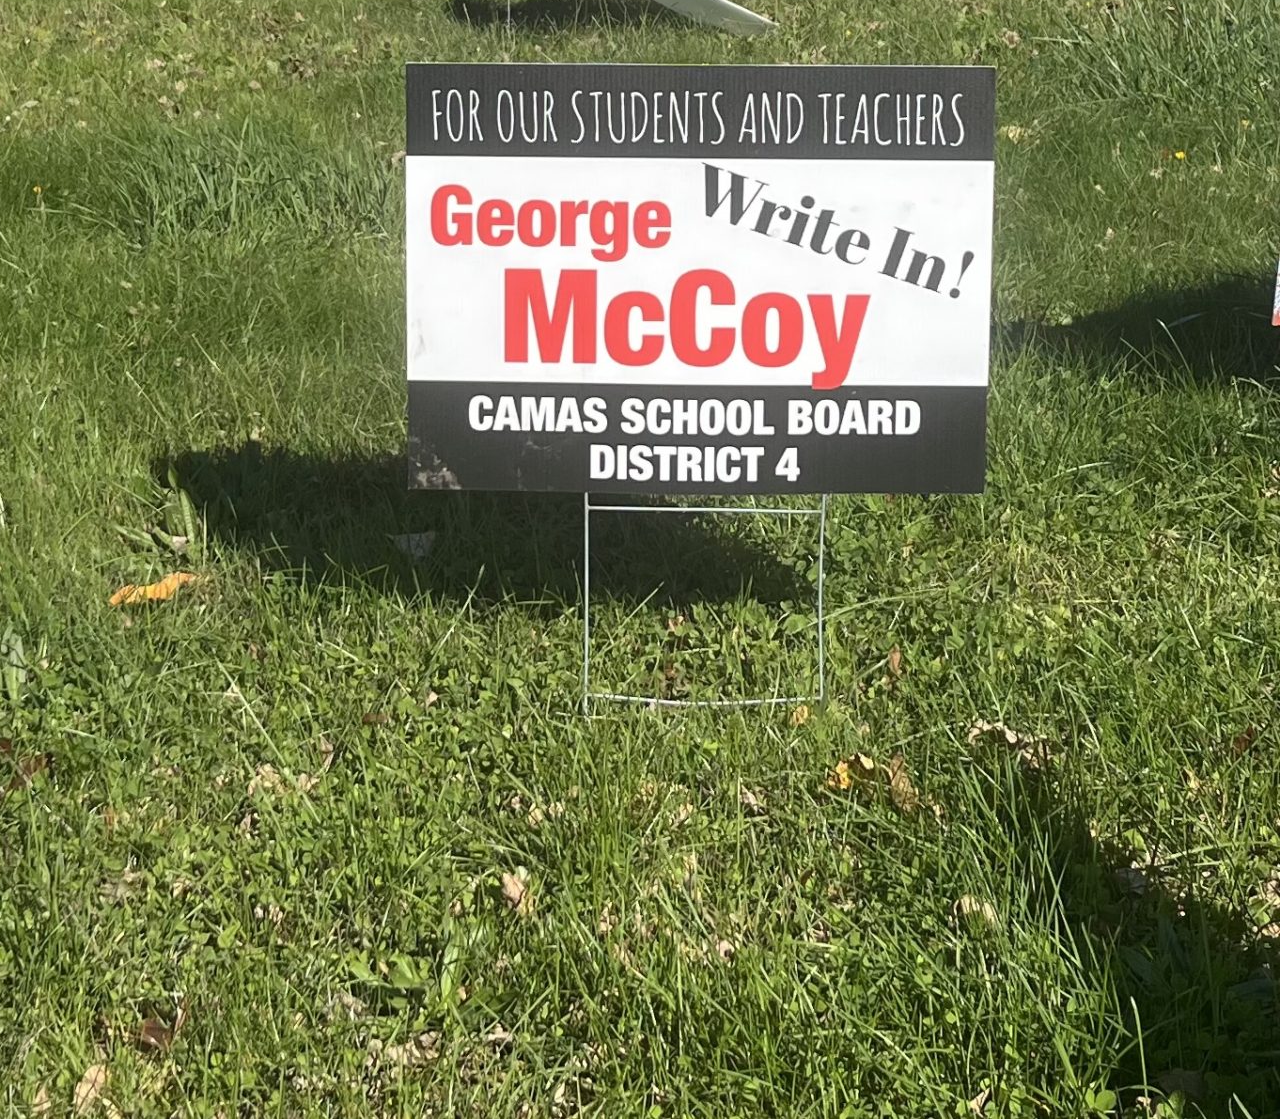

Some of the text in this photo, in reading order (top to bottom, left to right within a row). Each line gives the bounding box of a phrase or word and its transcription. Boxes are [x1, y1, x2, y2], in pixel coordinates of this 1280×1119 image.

[431, 88, 966, 148] FOR OUR STUDENTS AND TEACHERS
[430, 184, 672, 262] George
[701, 161, 976, 299] Write In!
[503, 267, 871, 390] McCoy
[468, 395, 921, 436] CAMAS SCHOOL BOARD
[589, 444, 801, 482] DISTRICT 4
